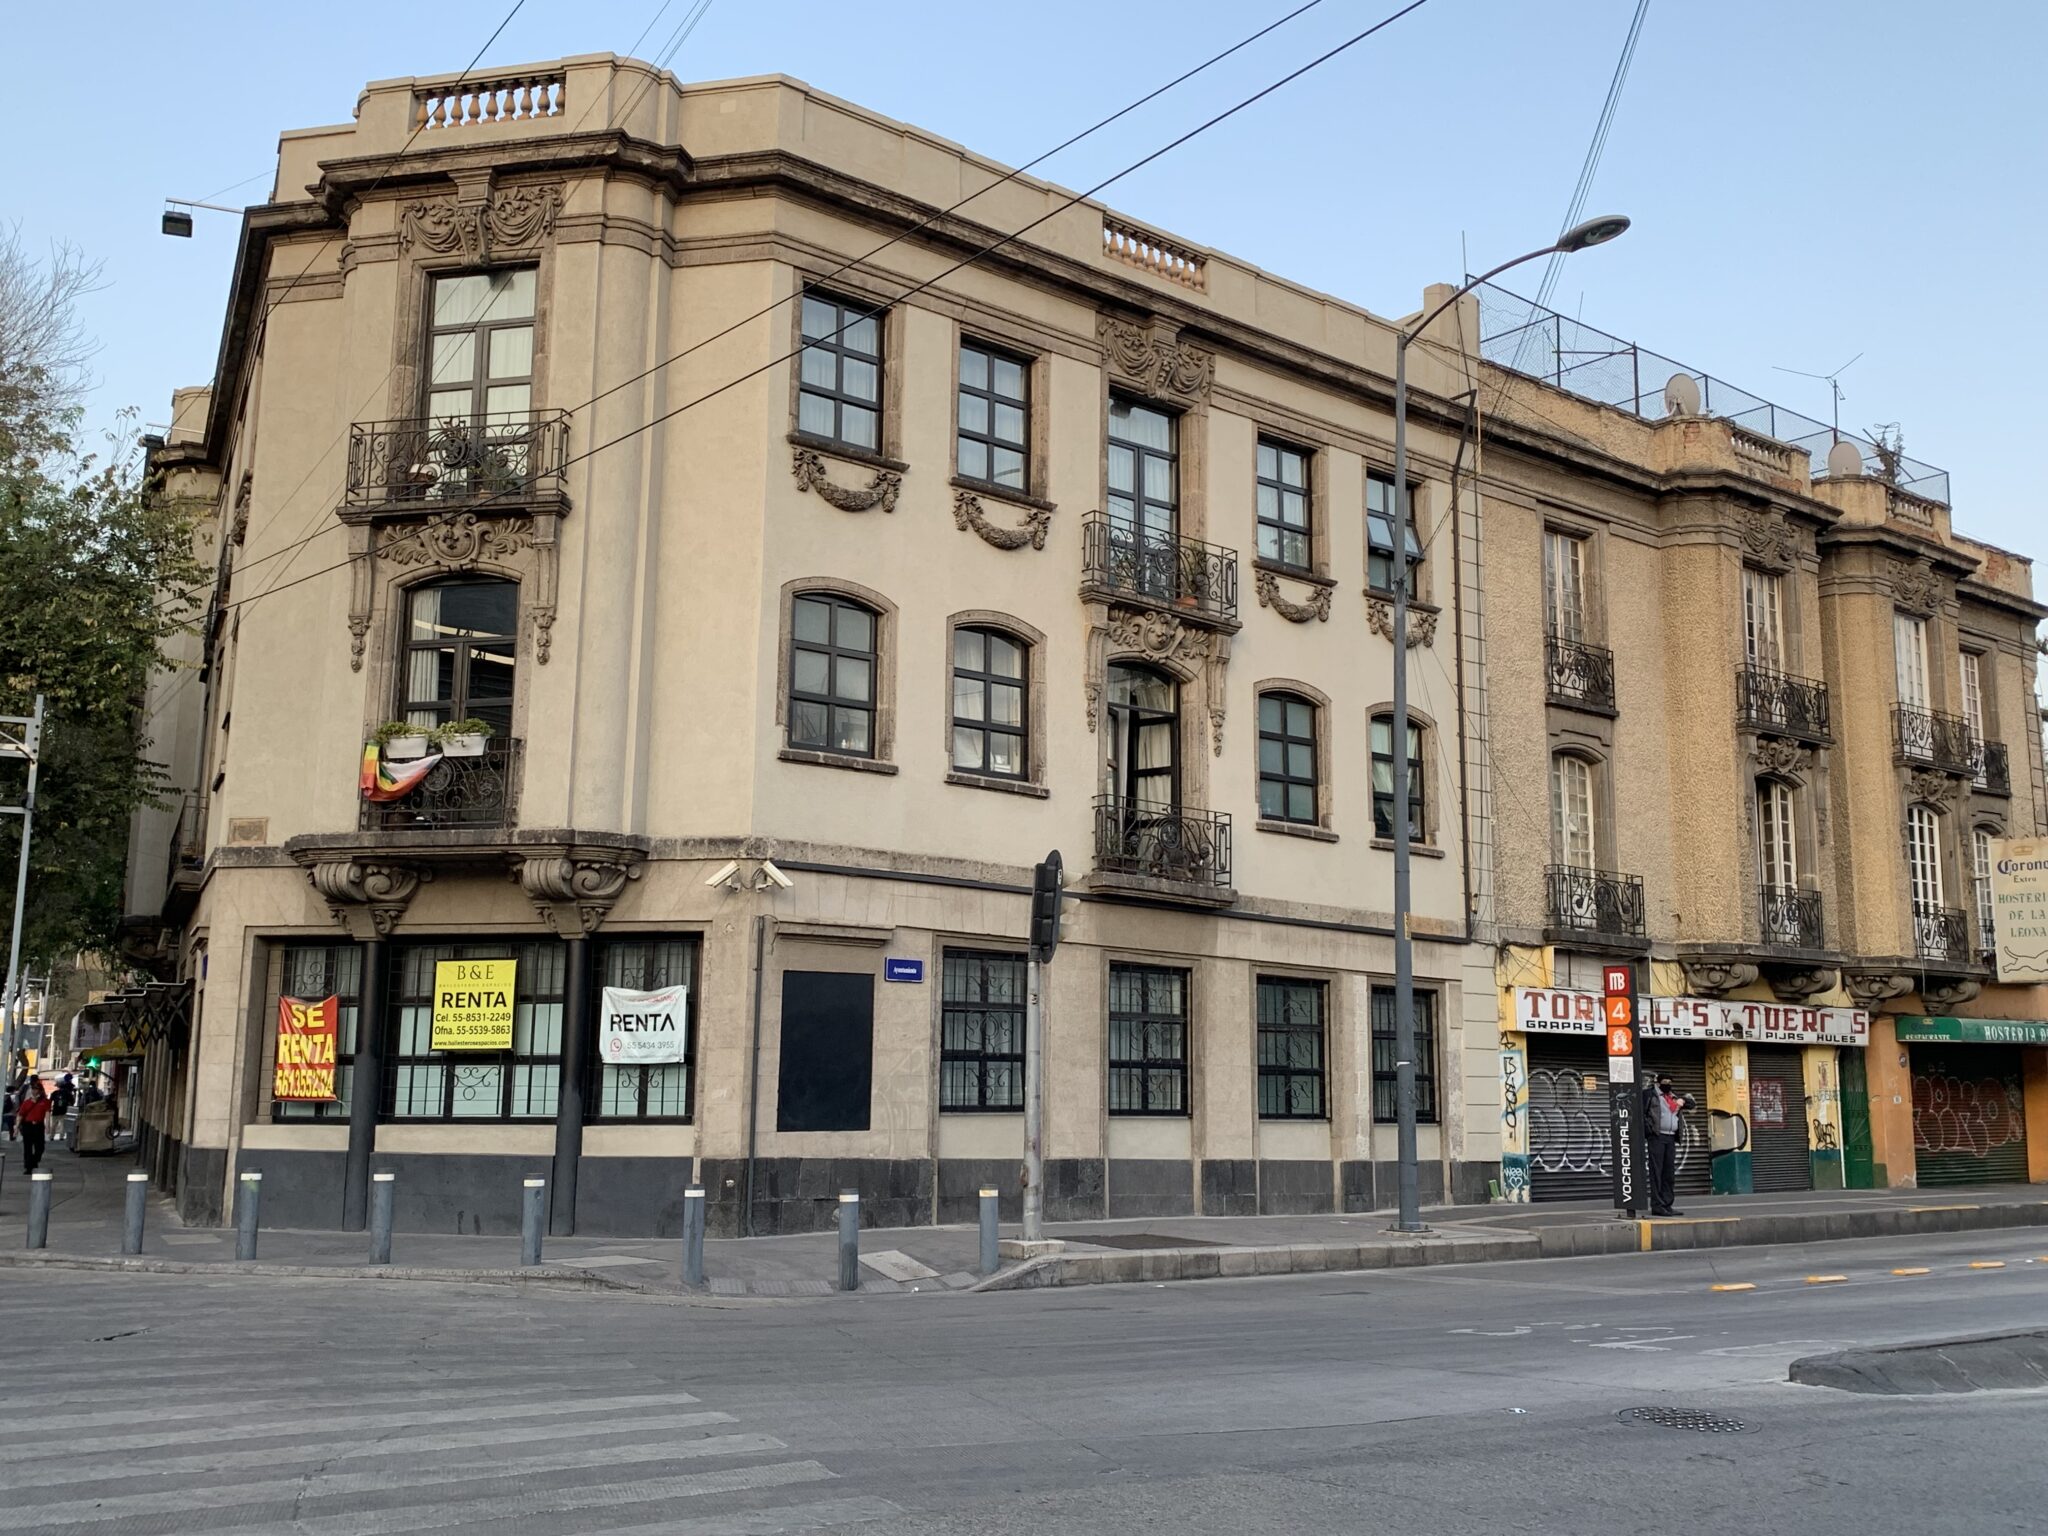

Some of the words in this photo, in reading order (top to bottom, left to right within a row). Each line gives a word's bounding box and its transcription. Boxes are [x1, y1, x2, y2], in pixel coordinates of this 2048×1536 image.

[2013, 875, 2036, 883] Extra
[2009, 910, 2024, 921] DE
[2031, 909, 2046, 920] LA
[2010, 926, 2047, 938] LEONA
[457, 965, 466, 981] B
[469, 964, 482, 980] &
[485, 964, 495, 980] E
[441, 991, 507, 1008] RENTA
[292, 1003, 325, 1028] SE
[435, 1013, 451, 1022] Cel.
[452, 1012, 511, 1022] 55-8531-2249
[1611, 1001, 1625, 1020] 4
[610, 1013, 675, 1032] RENTA
[1721, 1009, 1731, 1023] Y
[1742, 1005, 1866, 1035] TUERCS
[434, 1026, 455, 1035] Ofna.
[456, 1025, 511, 1035] 55-5539-5863
[1526, 1020, 1595, 1031] GRAPAS
[1705, 1029, 1753, 1038] GOMS
[1766, 1031, 1804, 1041] PIJAS
[1817, 1034, 1856, 1043] HULES
[1984, 1025, 2037, 1042] HOSTERIA
[278, 1033, 335, 1064] RENTA
[1619, 1108, 1629, 1118] 5
[1619, 1120, 1633, 1203] VOCACIONAL
